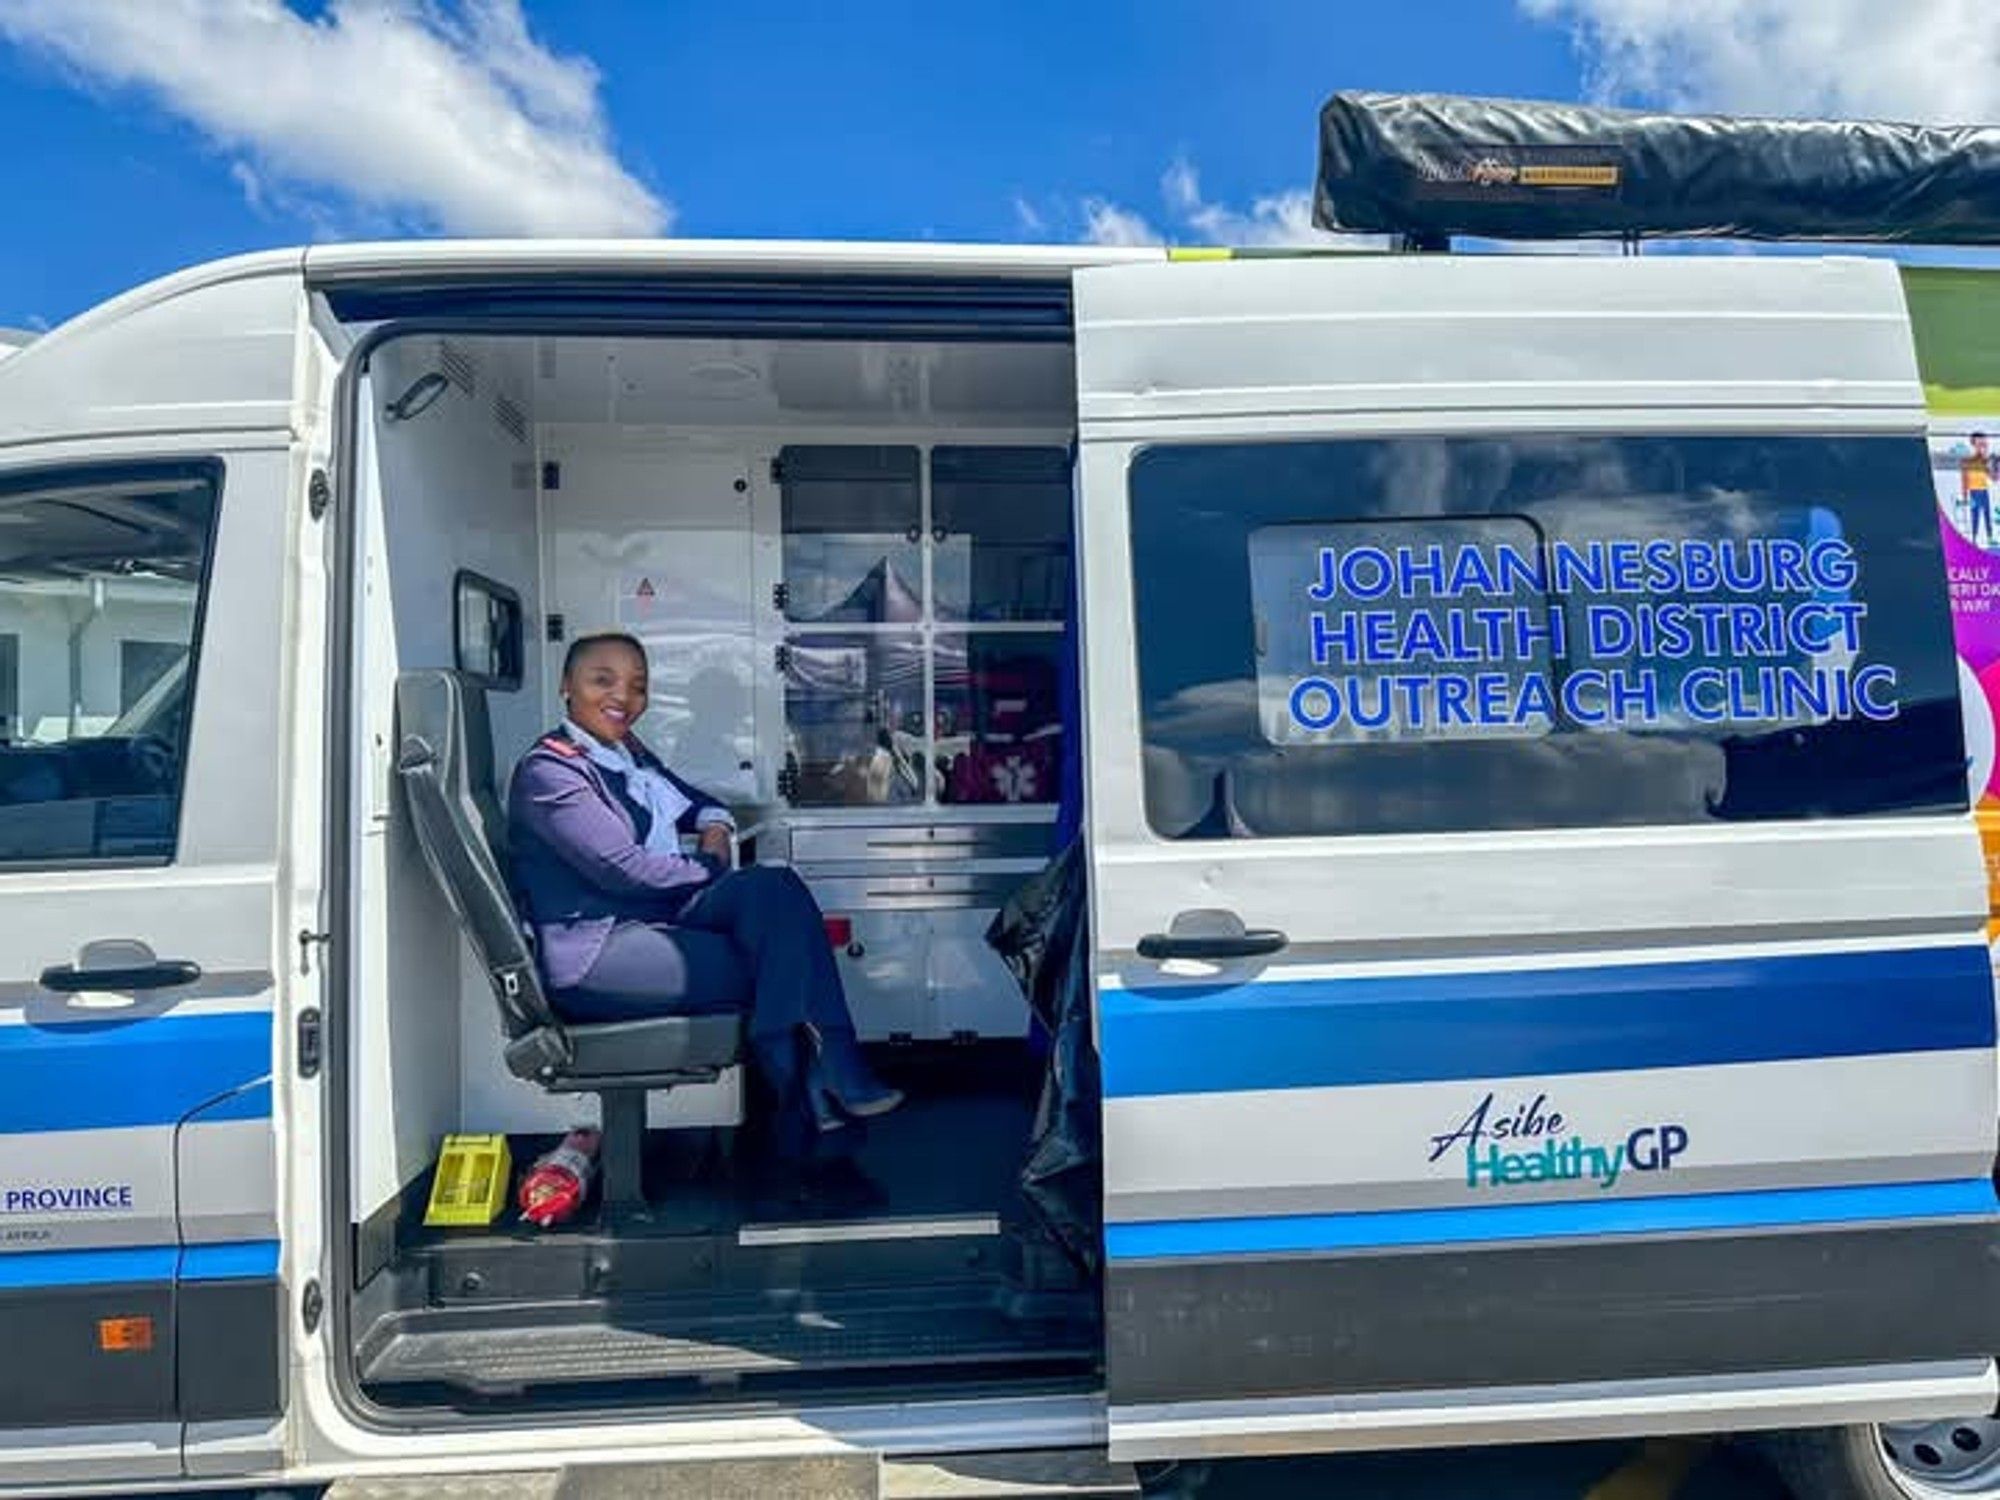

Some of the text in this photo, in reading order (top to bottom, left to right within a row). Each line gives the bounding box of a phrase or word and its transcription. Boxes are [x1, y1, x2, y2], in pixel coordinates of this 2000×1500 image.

[1308, 538, 1857, 600] JOHANNESBURG
[1310, 602, 1868, 665] HEALTH DISTRICT
[1288, 665, 1900, 731] OUTREACH CLINIC
[1428, 1092, 1566, 1162] Asibe
[6, 1185, 132, 1210] PROVINCE
